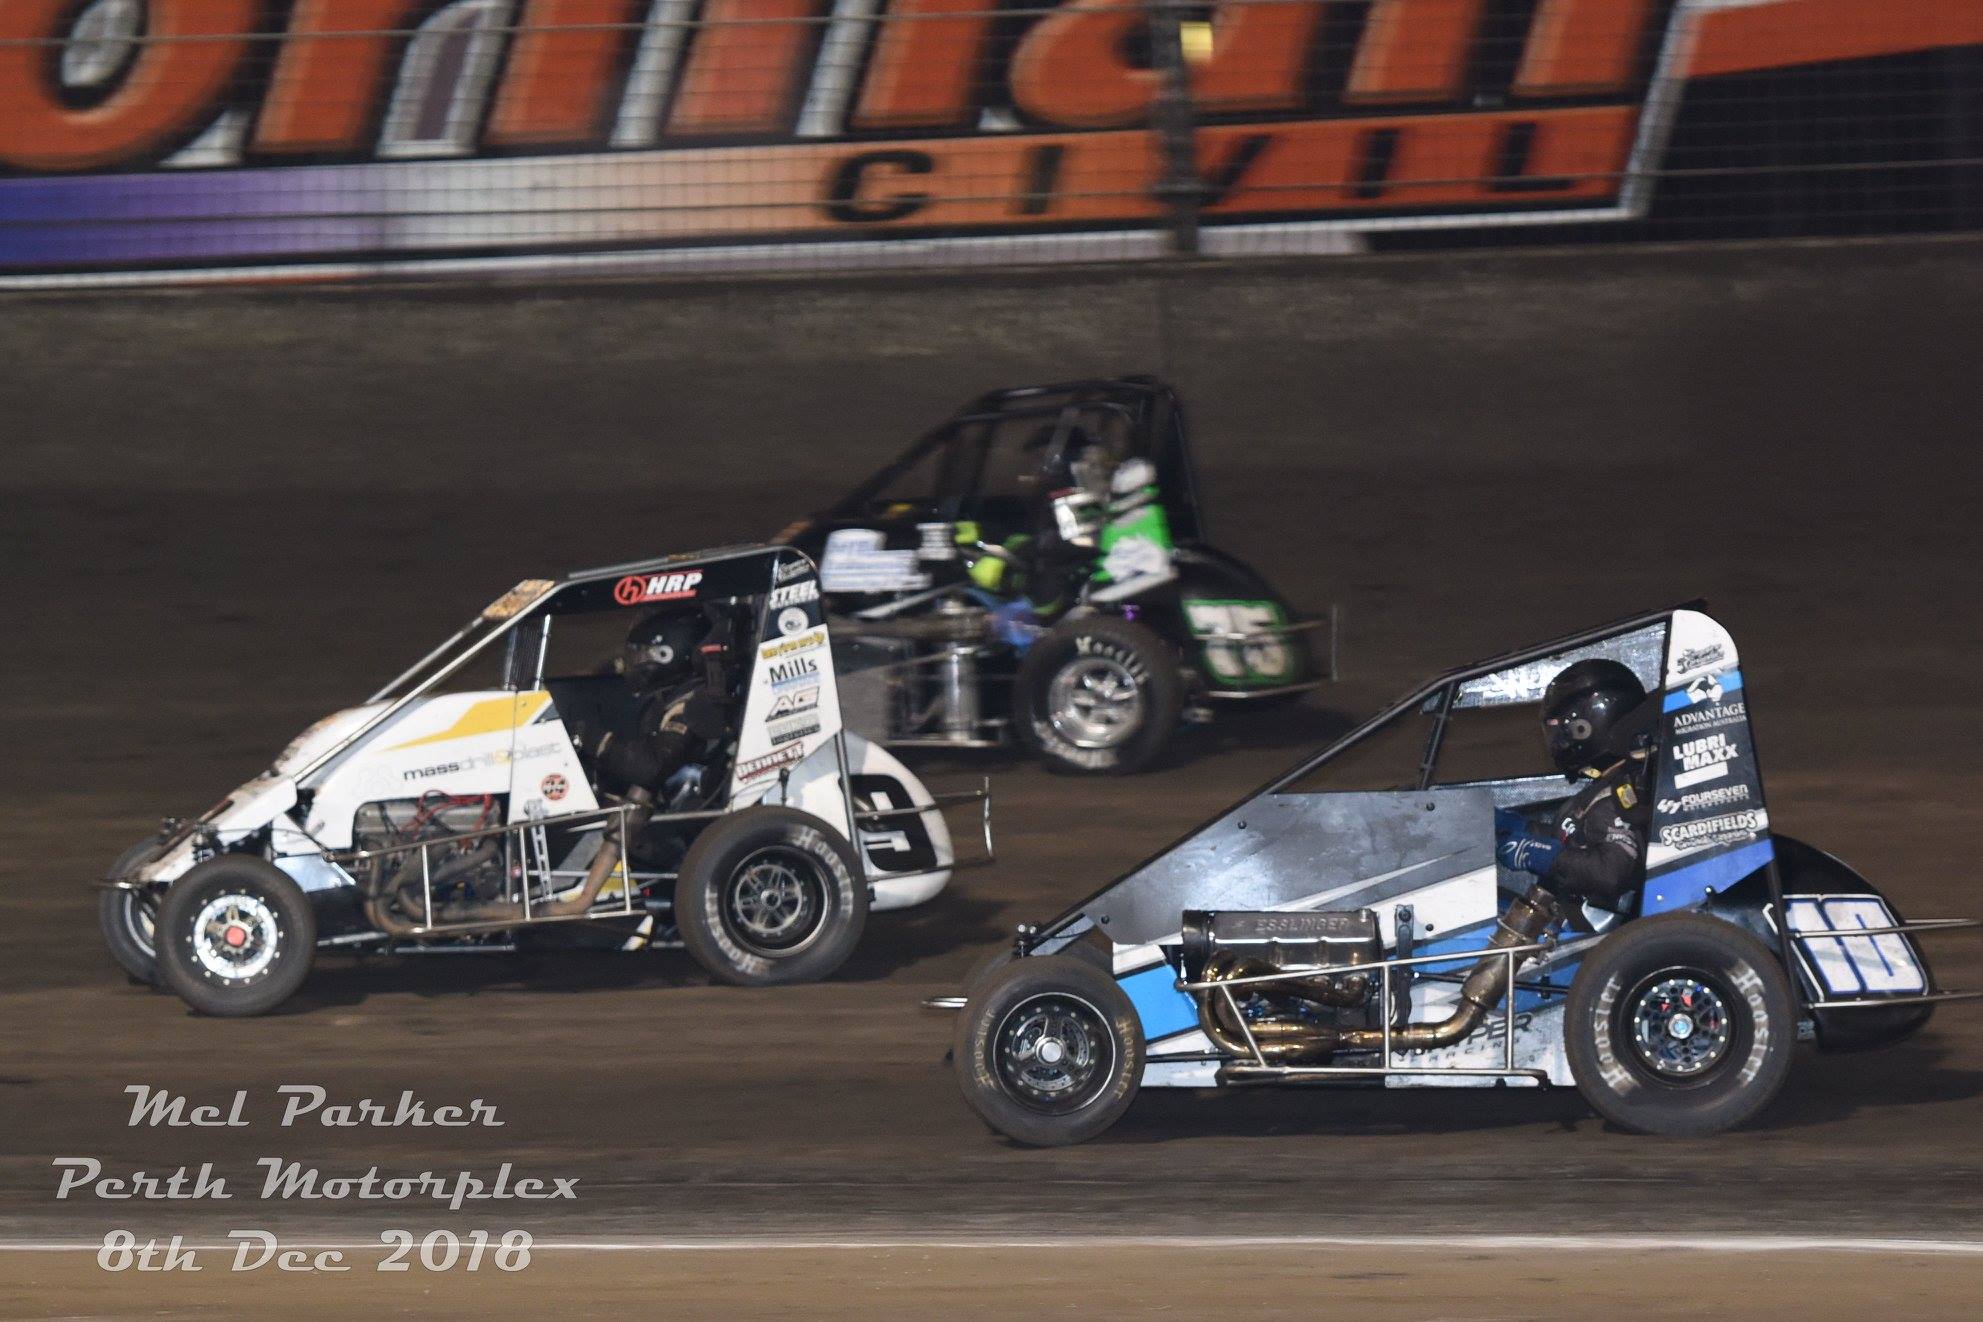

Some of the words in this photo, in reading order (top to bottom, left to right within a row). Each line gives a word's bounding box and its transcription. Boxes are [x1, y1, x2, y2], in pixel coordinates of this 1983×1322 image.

[646, 572, 704, 597] HRP
[769, 657, 819, 683] Mills
[1674, 702, 1746, 728] ADVANTAGE
[1673, 733, 1726, 760] LUBRI
[1683, 743, 1740, 771] MAXX
[1662, 811, 1757, 847] SCARDIFIELDS
[1254, 916, 1350, 933] ESSLINGER
[1787, 899, 1926, 995] 10
